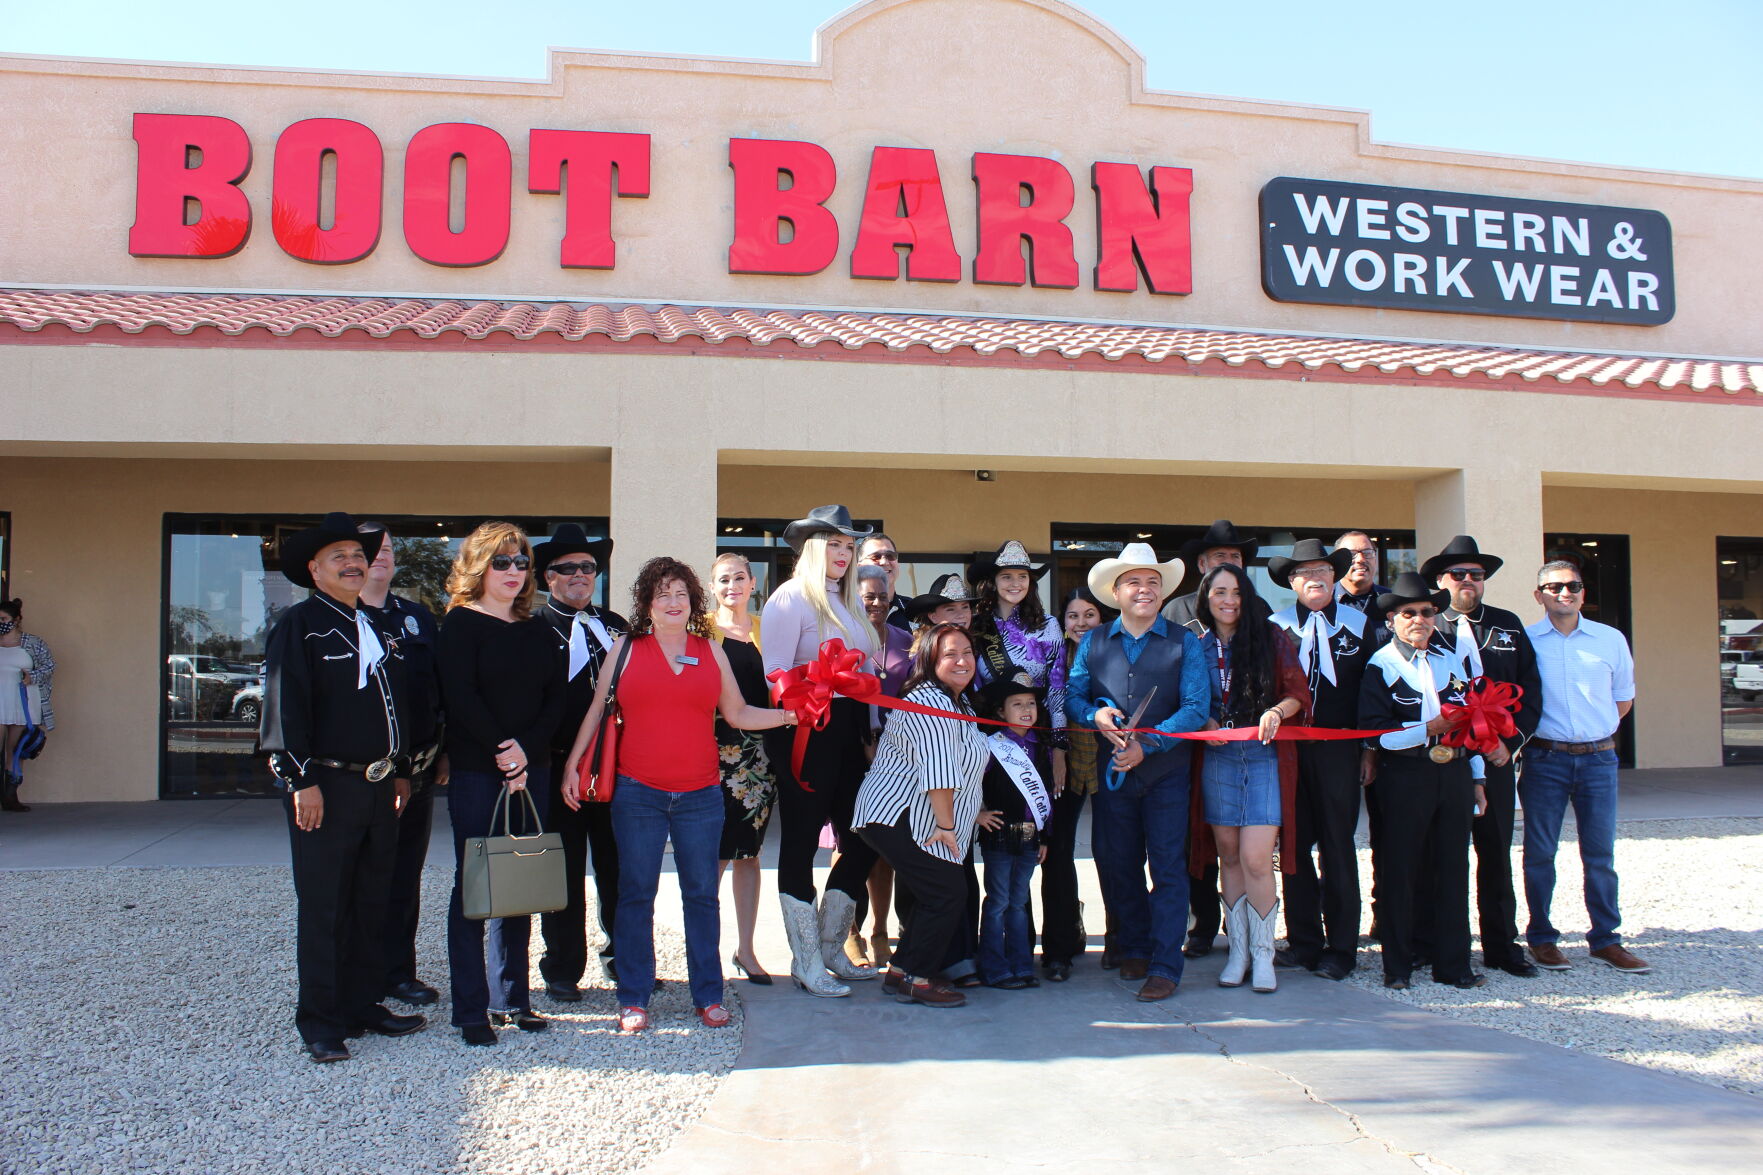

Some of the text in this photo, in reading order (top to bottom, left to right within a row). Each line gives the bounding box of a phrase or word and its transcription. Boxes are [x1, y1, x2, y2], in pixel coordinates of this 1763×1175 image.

[129, 112, 1193, 296] BOOT BARN
[1293, 193, 1648, 262] WESTERN &
[1282, 244, 1660, 311] WORK WEAR
[1020, 771, 1040, 796] Cattle
[1035, 795, 1048, 817] Call
